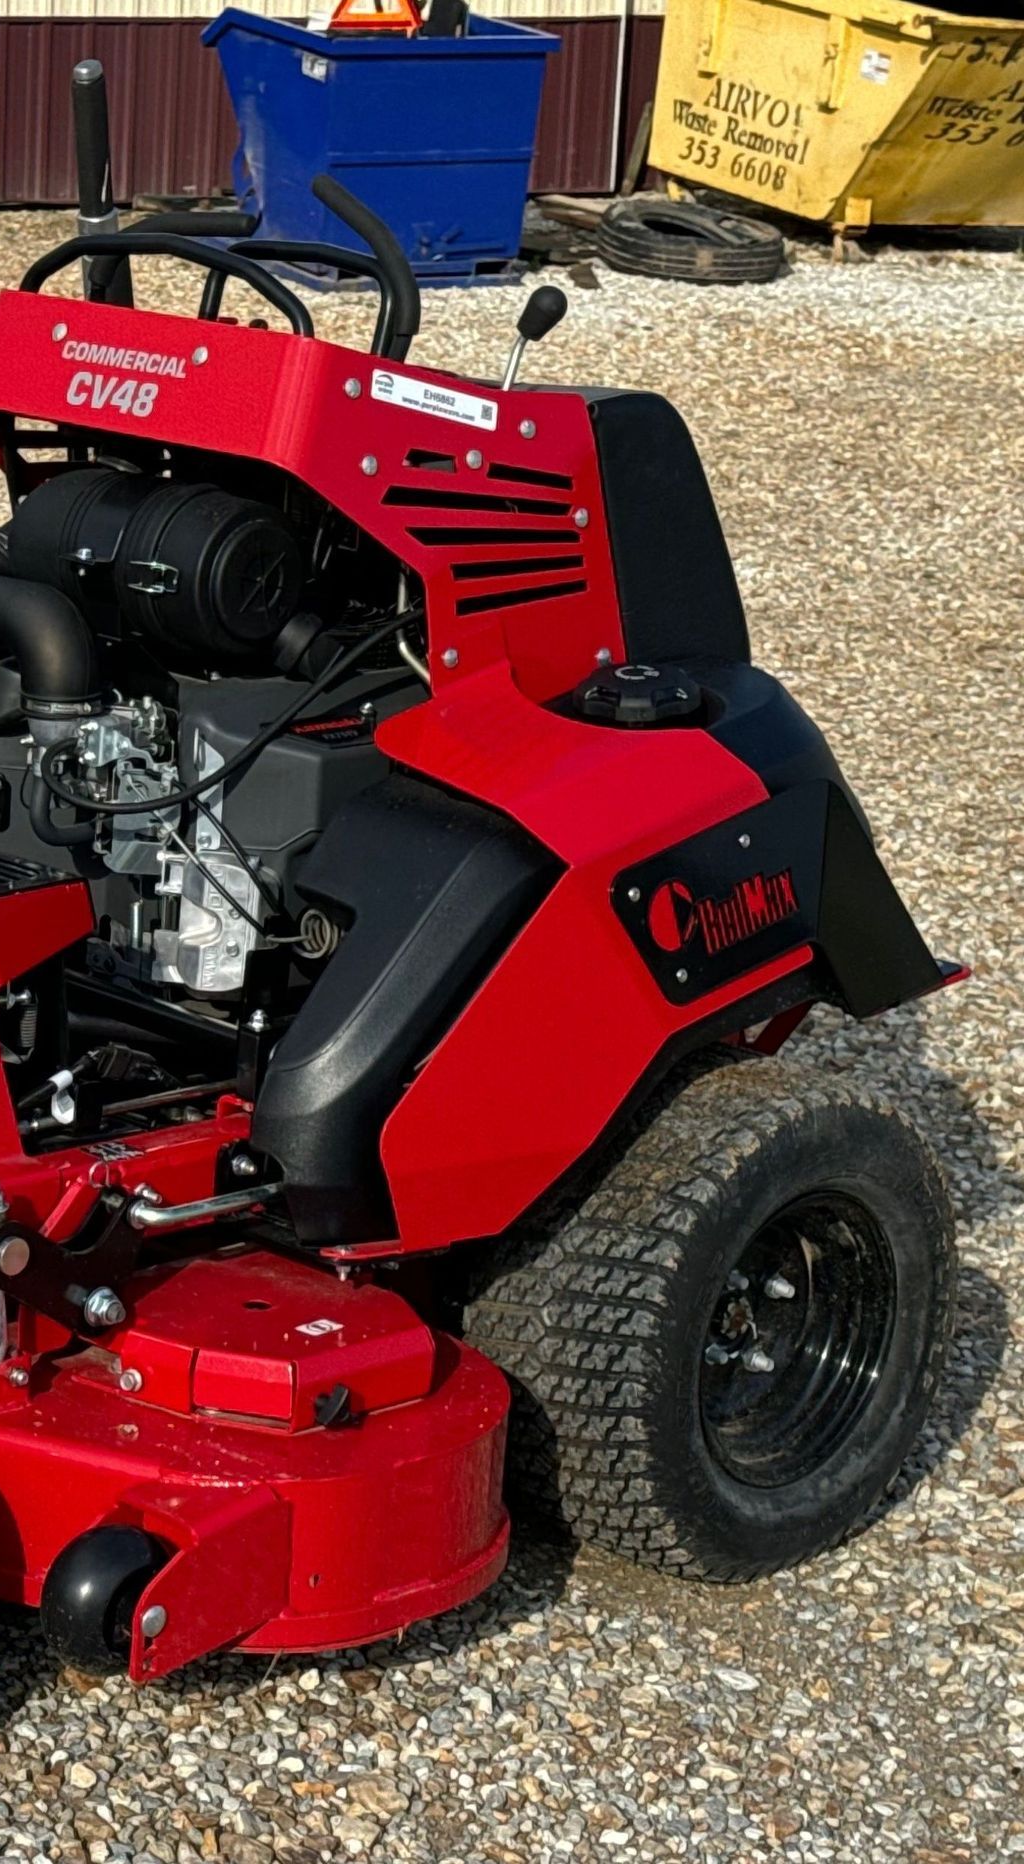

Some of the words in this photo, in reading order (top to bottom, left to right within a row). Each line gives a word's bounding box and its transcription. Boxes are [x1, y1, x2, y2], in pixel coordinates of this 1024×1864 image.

[673, 99, 718, 136] Waste
[722, 116, 810, 165] Removal
[924, 122, 999, 145] 353
[678, 137, 721, 169] 353
[730, 152, 787, 191] 6608
[61, 340, 187, 379] COMMERCIAL
[66, 371, 159, 418] CV48
[698, 871, 798, 954] RedMax
